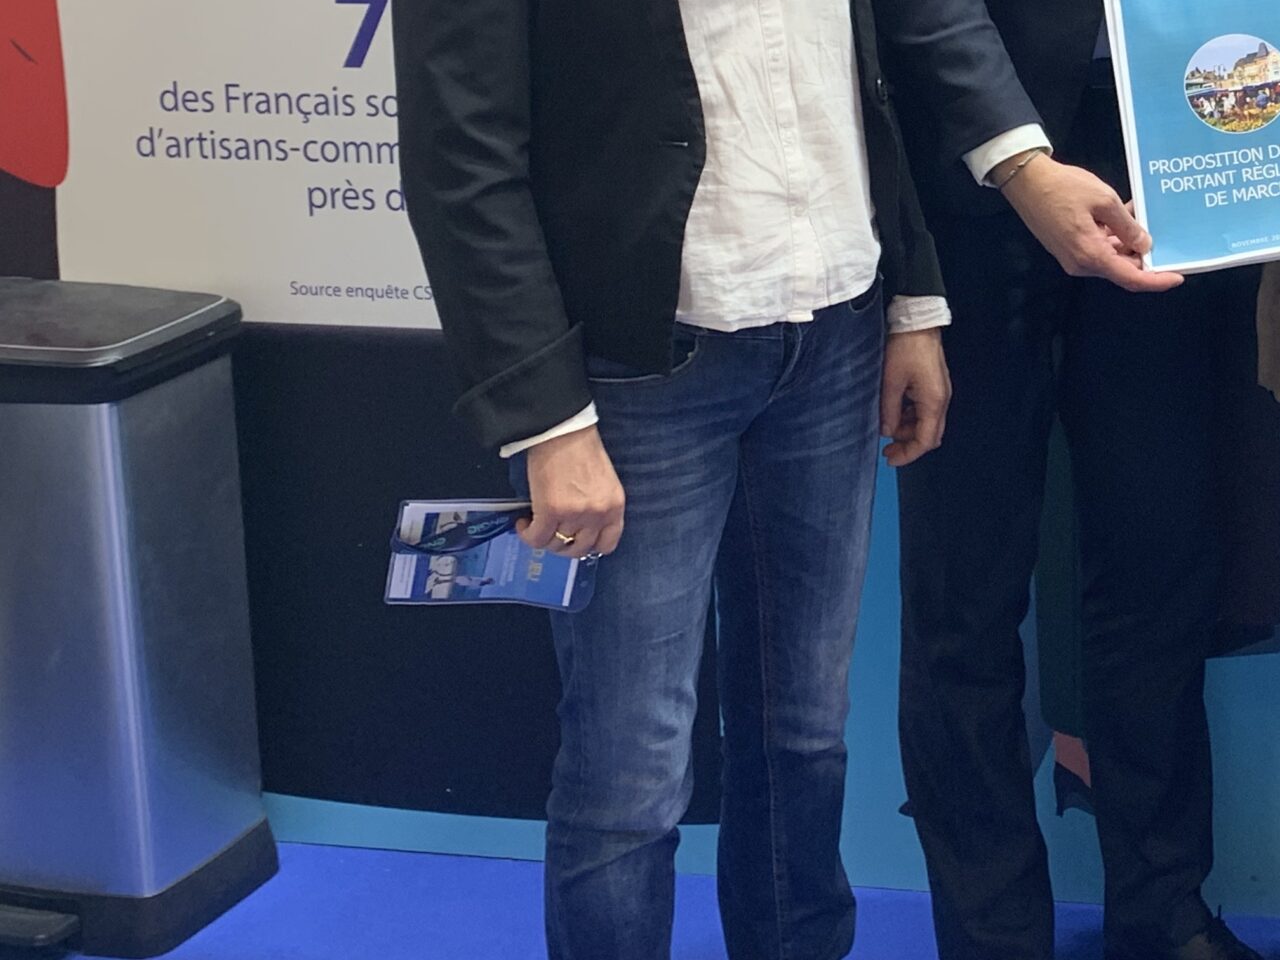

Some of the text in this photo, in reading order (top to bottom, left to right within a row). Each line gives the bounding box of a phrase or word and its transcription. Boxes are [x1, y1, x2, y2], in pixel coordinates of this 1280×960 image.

[159, 81, 399, 123] des Français so
[136, 127, 400, 164] d'artisans-comm
[1149, 147, 1264, 175] PROPOSITION
[1160, 170, 1237, 194] PORTANT
[307, 179, 406, 217] près d
[1205, 192, 1228, 208] DE
[290, 281, 433, 302] Source enquête CS
